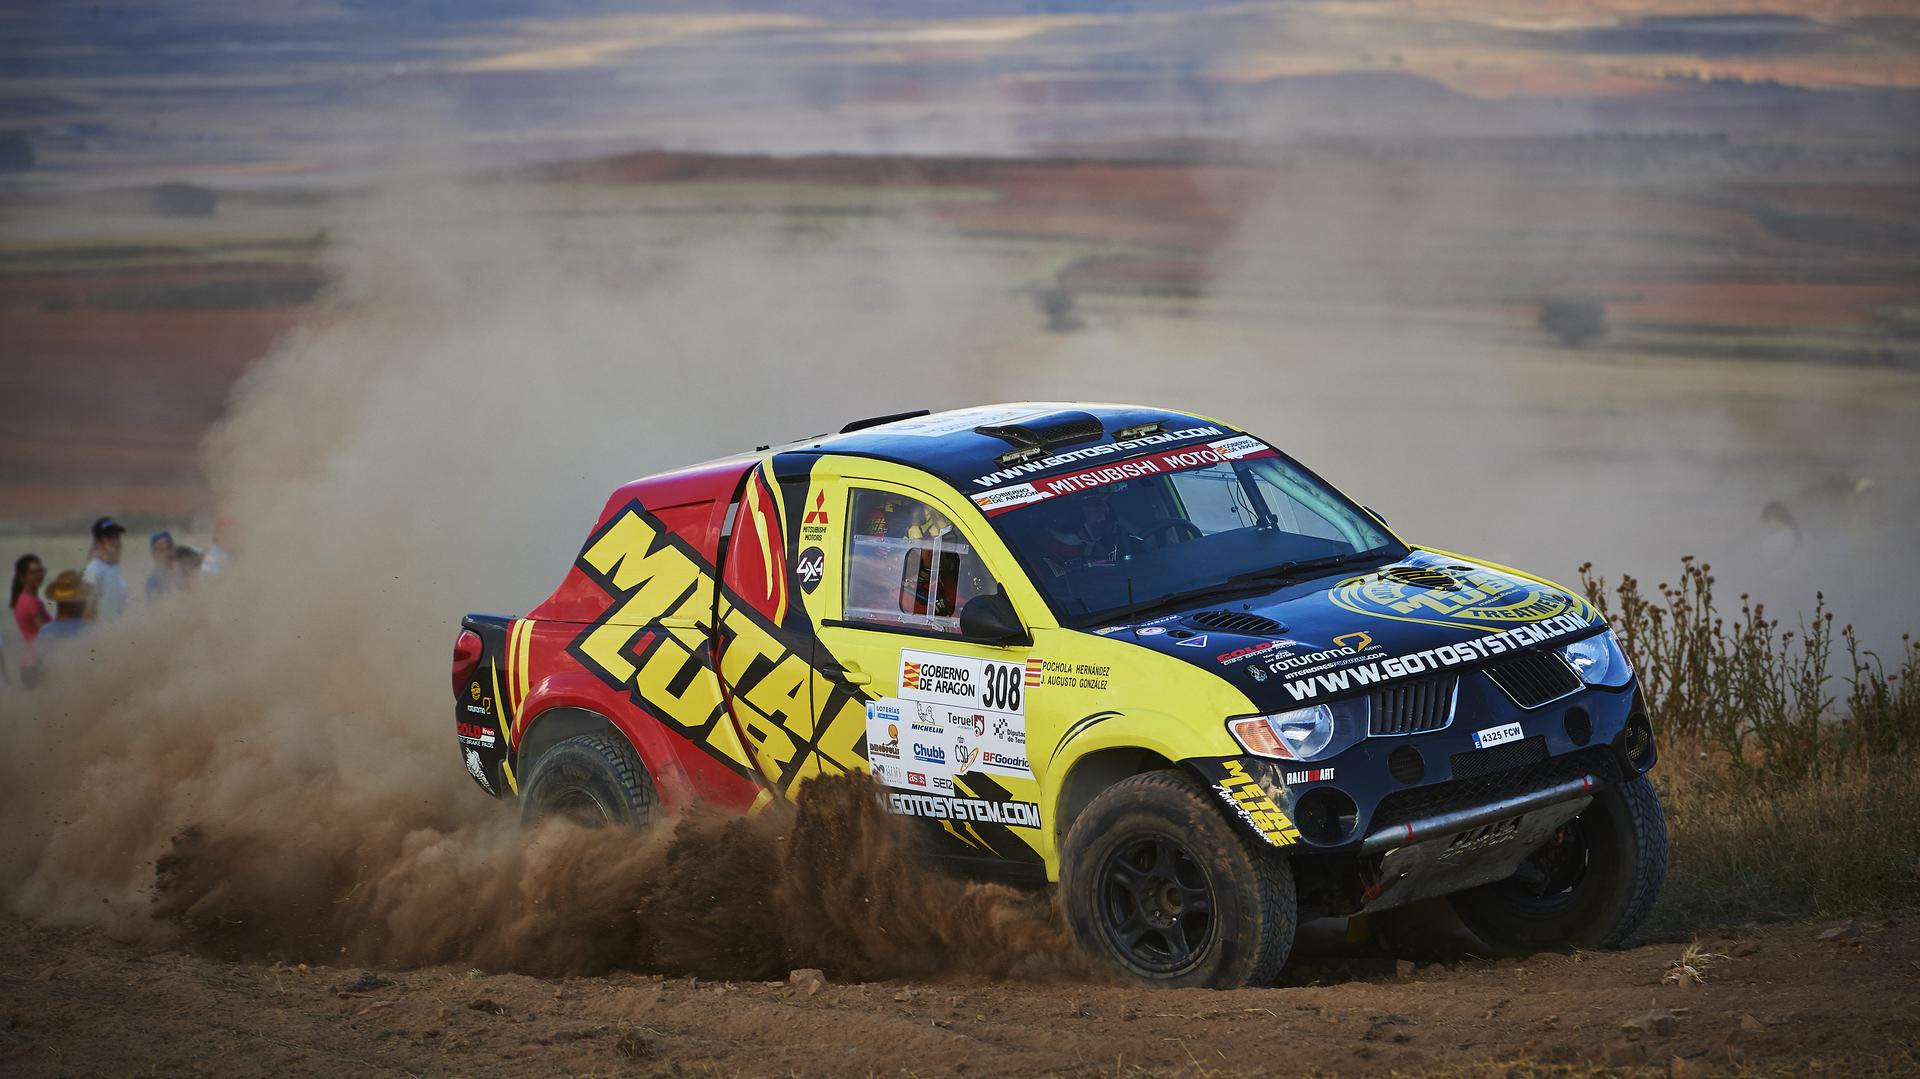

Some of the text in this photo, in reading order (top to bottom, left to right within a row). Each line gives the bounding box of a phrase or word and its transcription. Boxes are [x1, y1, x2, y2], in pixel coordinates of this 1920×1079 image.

[973, 426, 1224, 487] WWW.GOTOSYSTEM.COM
[1047, 448, 1243, 496] MITSUBISHI MOTO
[988, 487, 1030, 500] GOBIERNO
[1283, 611, 1592, 701] WWW.GOTOSYSTEM.COM
[921, 663, 970, 682] GOBIERNO
[1042, 660, 1110, 677] POCHOLA HERNÁNDEZ
[919, 679, 976, 698] DE ARAGON
[982, 663, 1022, 712] 308
[1040, 675, 1108, 690] J. AUGUSTO GONZÁLEZ
[911, 723, 944, 734] MICHELIN
[948, 712, 974, 727] Teruel
[1482, 726, 1521, 743] 4325 FCW
[913, 742, 945, 760] Chubb
